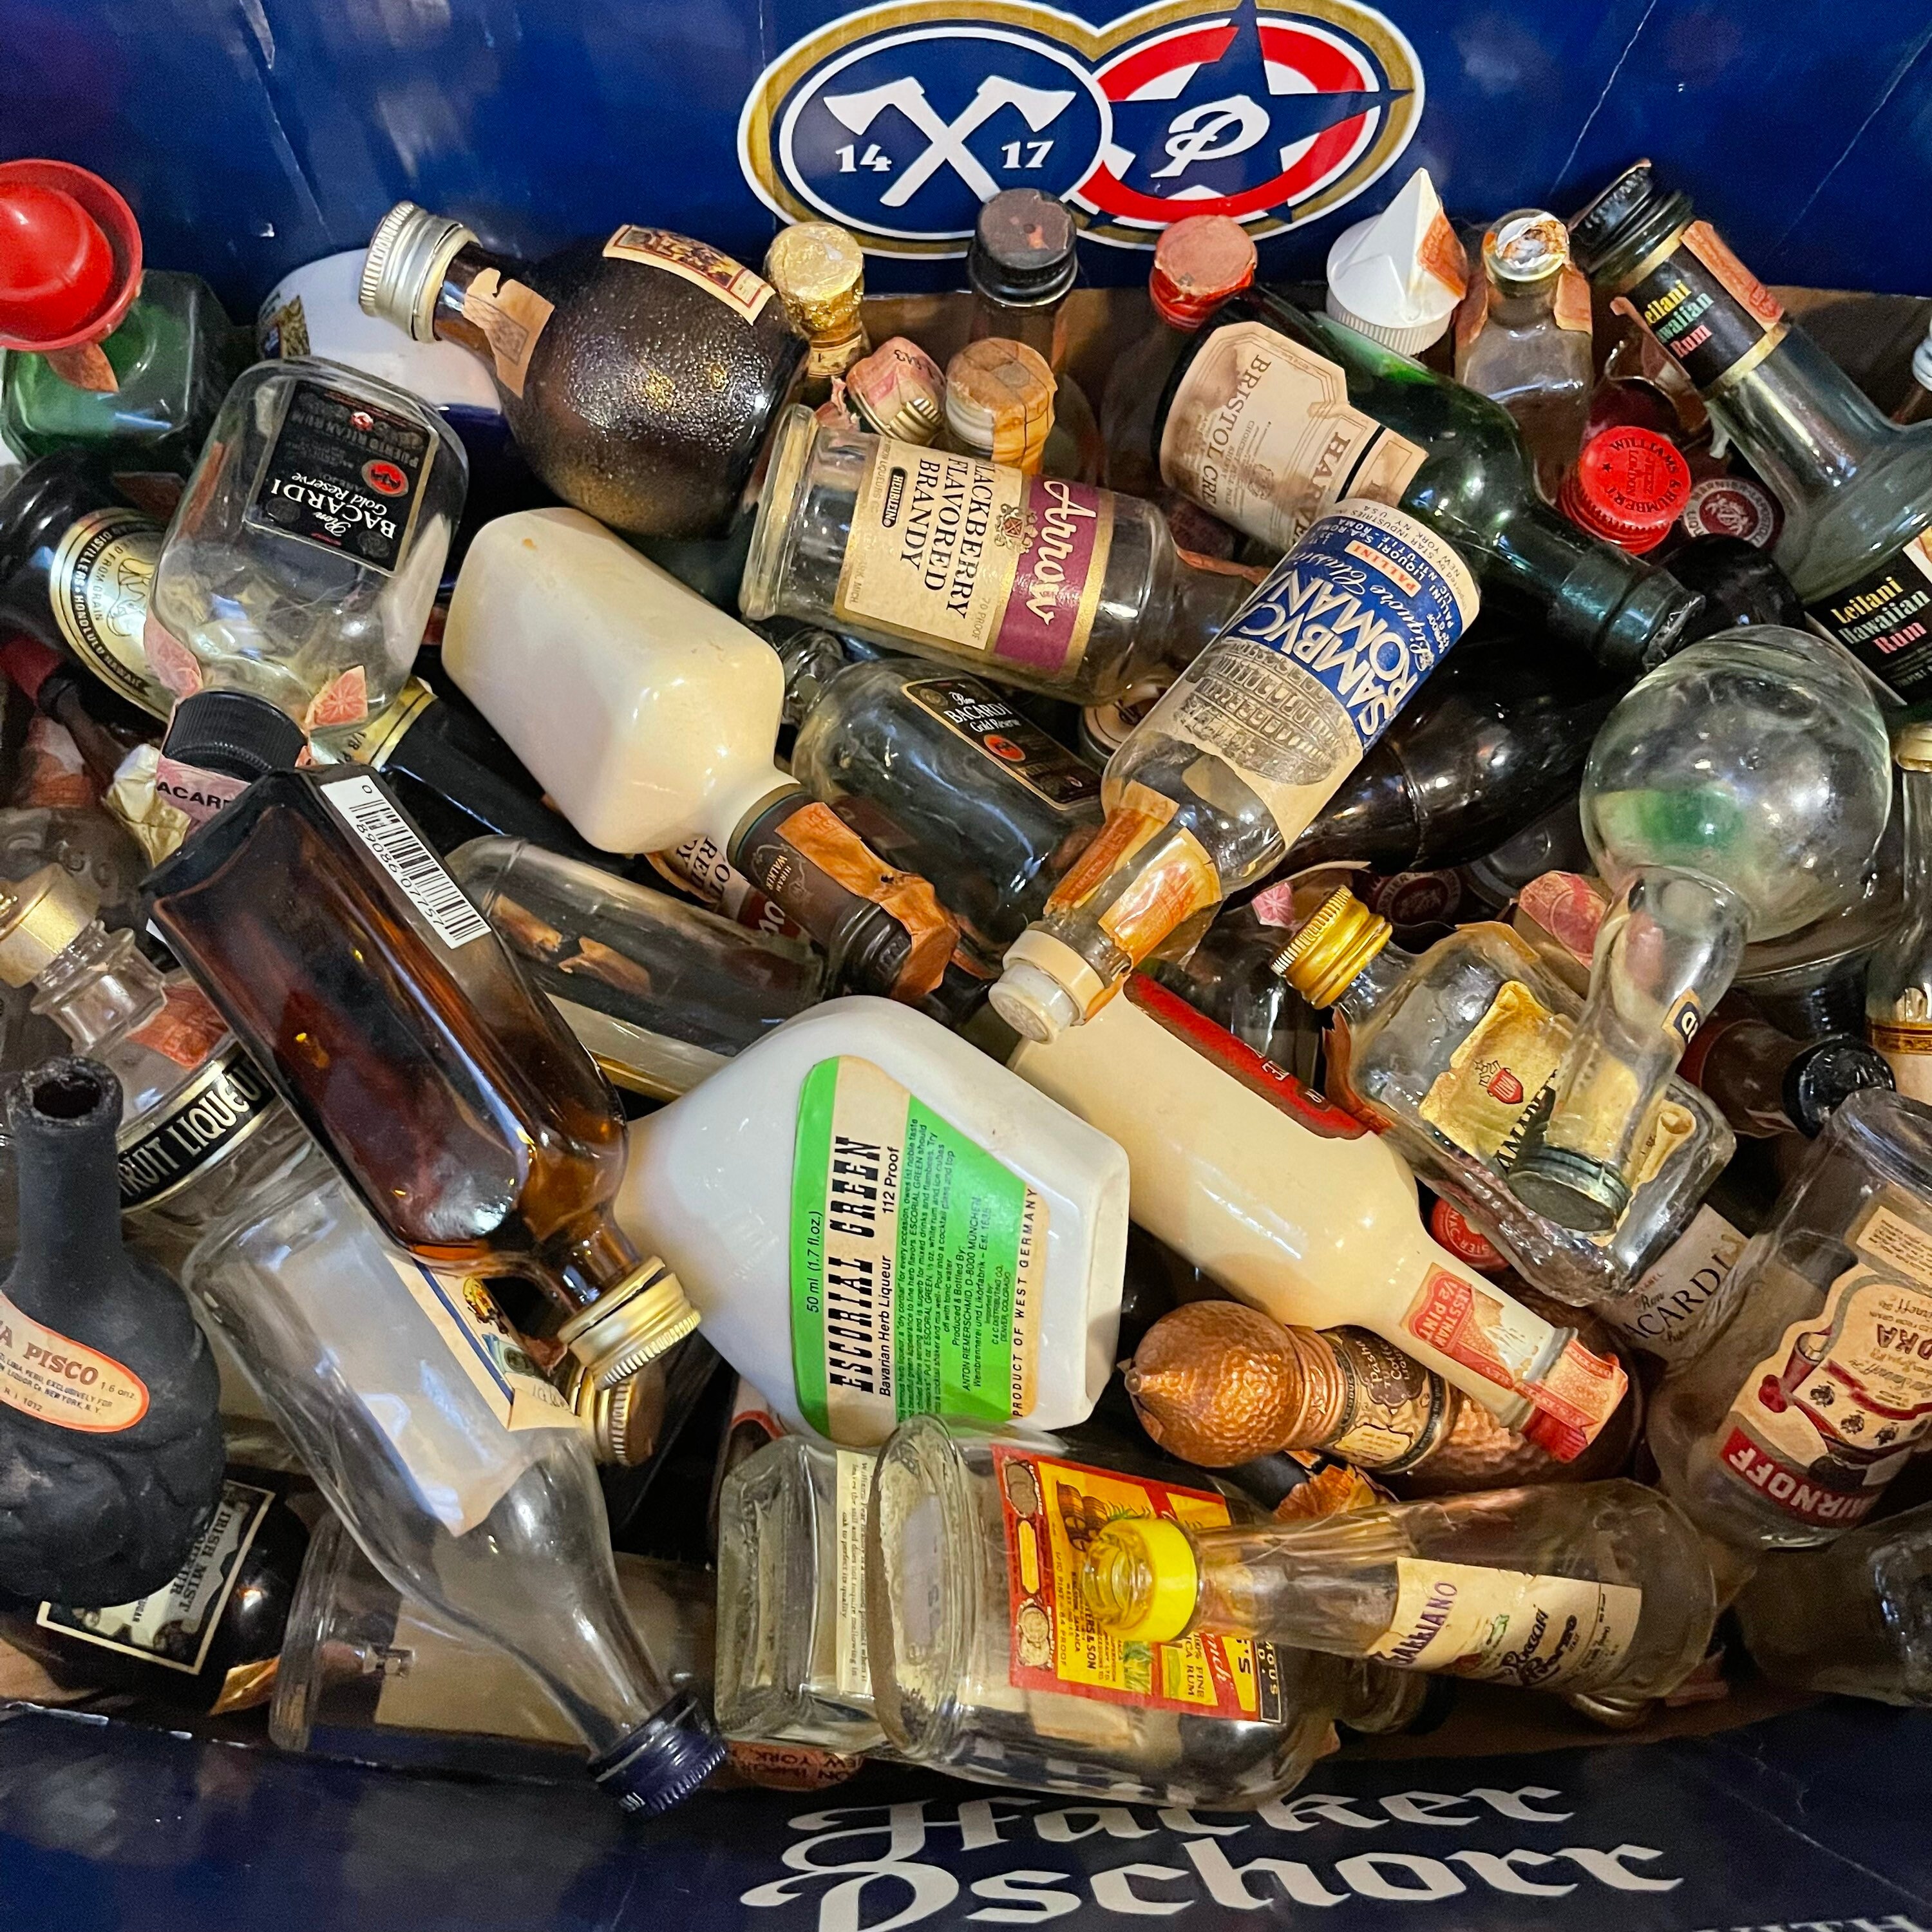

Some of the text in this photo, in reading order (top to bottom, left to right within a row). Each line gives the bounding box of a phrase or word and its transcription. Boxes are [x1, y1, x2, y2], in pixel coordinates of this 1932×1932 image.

[838, 139, 1047, 173] 14 17
[1644, 279, 1692, 324] eilani
[1670, 325, 1712, 358] Rum
[1207, 354, 1273, 459] BRISTOL
[1611, 436, 1680, 475] WILLIAMS
[1627, 449, 1639, 497] LONDON
[270, 479, 397, 539] BACARDI
[292, 472, 388, 516] Gold Reserve
[885, 474, 904, 523] HEUBLEIN
[900, 458, 941, 571] BRANDY
[924, 458, 969, 591] FLAVORED
[1394, 516, 1411, 531] NY
[1026, 480, 1096, 625] Arrow
[1350, 508, 1446, 571] by STAR INDUSTRIES
[1414, 531, 1441, 553] YORK
[75, 533, 113, 587] DISTILLERS
[1338, 517, 1453, 603] LIC ROMA
[1352, 545, 1415, 593] PALLINI
[1439, 554, 1461, 576] NEW
[93, 552, 116, 622] FROM GRAIN
[1379, 542, 1454, 629] PALLINI LIQUORI
[74, 594, 105, 656] HONOLULU
[971, 611, 988, 641] PROOF
[1370, 583, 1431, 665] Liquore
[943, 703, 1013, 724] BACARDI
[970, 718, 995, 733] Gold
[355, 822, 401, 874] 89086
[400, 876, 444, 929] 07757
[113, 1062, 263, 1198] RUIT LIQUEU
[909, 1118, 918, 1140] taste
[916, 1124, 927, 1154] should
[927, 1132, 938, 1146] Try
[905, 1142, 915, 1166] noble
[935, 1144, 944, 1171] cubes
[913, 1157, 923, 1188] GREEN
[909, 1191, 920, 1235] ESCORIAL
[931, 1188, 939, 1205] and
[918, 1211, 927, 1238] drinks
[927, 1226, 936, 1247] white
[806, 1249, 821, 1271] (1.7
[828, 1136, 881, 1395] ESCORIAL GREEN
[898, 1247, 907, 1269] every
[916, 1240, 926, 1265] mixed
[931, 1150, 955, 1366] shaker and Pour cocktail and top
[965, 1252, 976, 1285] D-8000
[806, 1277, 819, 1293] ml
[876, 1146, 898, 1398] Bavarian Herb Liqueur 112 Proof
[906, 1267, 914, 1285] herb
[916, 1265, 925, 1278] for
[806, 1296, 819, 1312] 50
[914, 1280, 925, 1307] superb
[942, 1259, 953, 1320] with tonic water
[951, 1263, 964, 1346] Produced Bottled
[991, 1278, 1003, 1326] DISTRIBUTING
[1001, 1271, 1011, 1312] COLORADO
[1012, 1186, 1037, 1417] PRODUCT OF WEST GERMANY
[1450, 1287, 1470, 1316] LESS
[1620, 1249, 1734, 1349] ACARDI
[905, 1313, 916, 1356] appearance
[914, 1318, 923, 1332] and
[921, 1307, 934, 1345] ESCORIAL
[974, 1309, 983, 1327] und
[1419, 1302, 1446, 1338] PINT
[1432, 1316, 1458, 1345] THAN
[22, 1342, 99, 1385] PISCO
[961, 1360, 970, 1390] ANTON
[972, 1329, 981, 1387] Weinbrennerei
[43, 1388, 62, 1400] NEW
[46, 1379, 95, 1403] EXCLUSIVELY
[97, 1397, 113, 1408] FOR
[839, 1540, 849, 1570] perfect
[179, 1562, 211, 1613] MIST
[838, 1586, 848, 1618] quality
[849, 1616, 859, 1663] mellowing
[1086, 1643, 1097, 1671] SON
[1187, 1664, 1196, 1696] RUM
[1196, 1665, 1206, 1699] FINE
